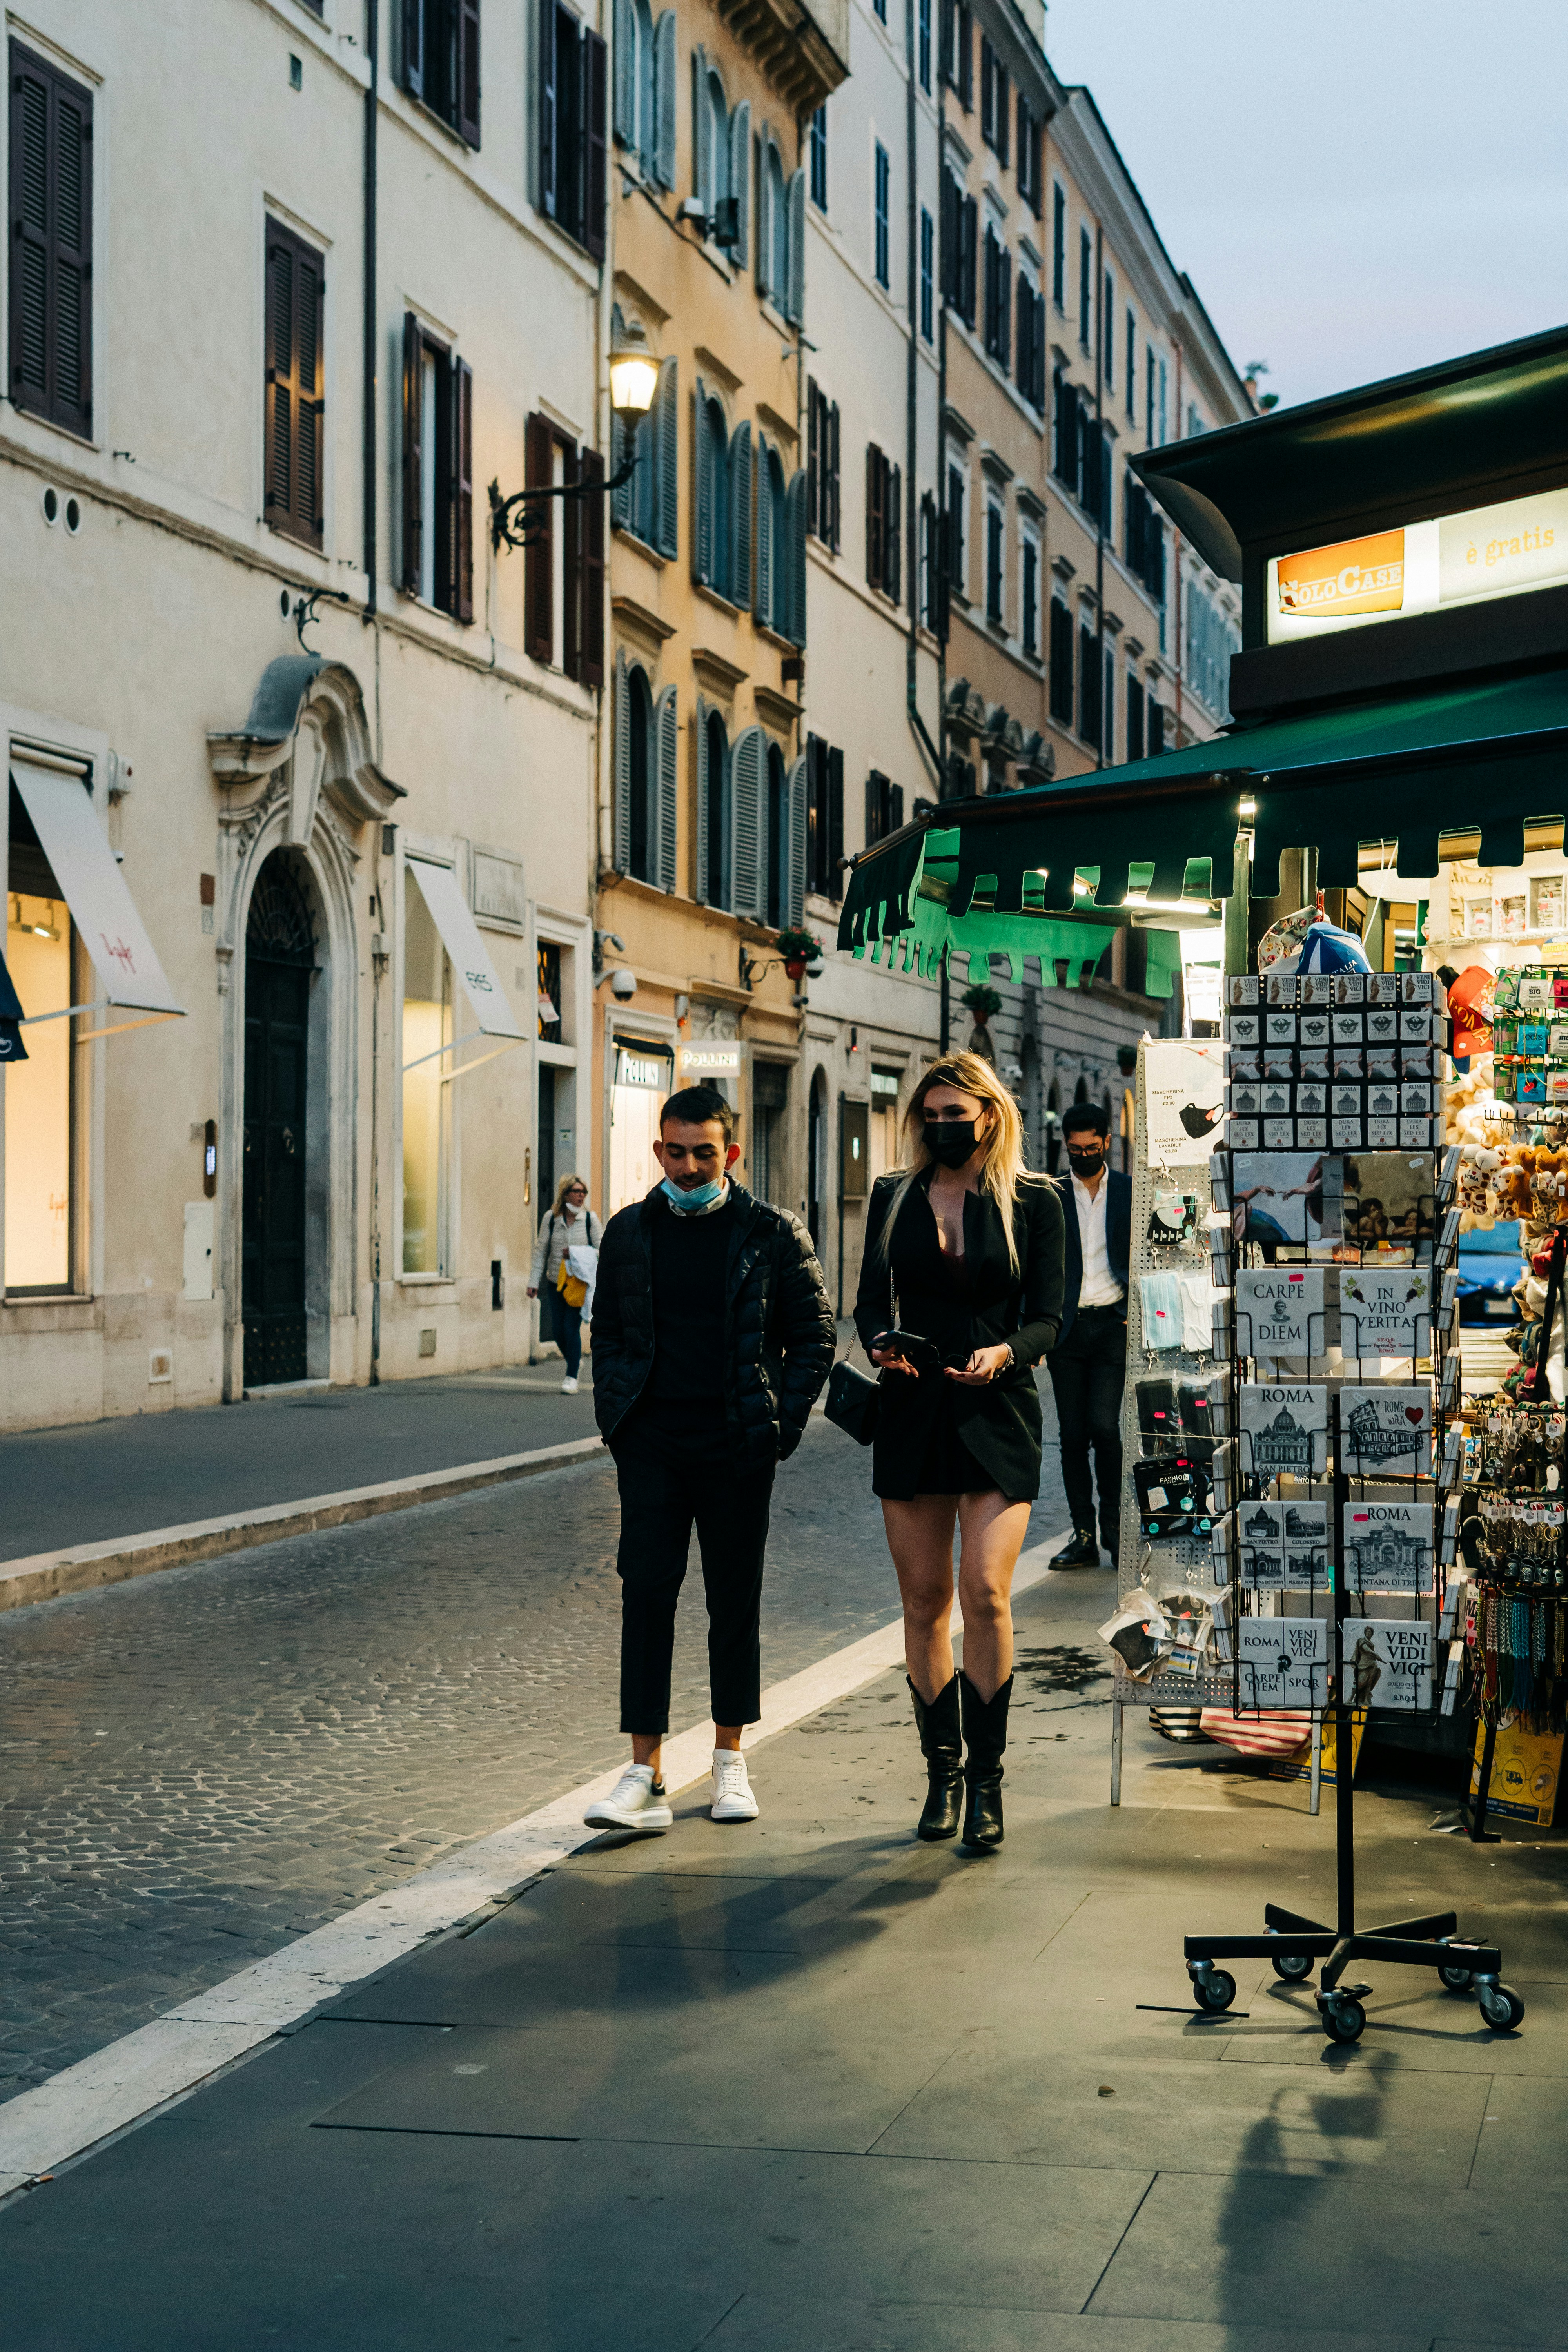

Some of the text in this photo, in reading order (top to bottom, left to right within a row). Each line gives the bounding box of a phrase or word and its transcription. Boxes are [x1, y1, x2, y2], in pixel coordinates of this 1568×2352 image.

[1466, 526, 1554, 566] è gratis
[1449, 996, 1492, 1047] ROMA
[683, 1051, 737, 1066] POLLINI
[1254, 1284, 1304, 1298] CARPE
[1377, 1287, 1393, 1299] IN
[1368, 1302, 1405, 1314] VINO
[1357, 1316, 1418, 1328] VERITAS
[1259, 1325, 1301, 1339] DIEM
[1261, 1389, 1314, 1403] ROMA
[1384, 1401, 1405, 1412] ROME
[1160, 1474, 1189, 1483] FASHION
[1367, 1508, 1411, 1521] ROMA
[1289, 1629, 1318, 1639] VENI
[1385, 1631, 1428, 1646] VENI
[1244, 1637, 1281, 1647] ROMA
[1290, 1639, 1316, 1648] VIDI
[1291, 1647, 1316, 1657] VICI
[1387, 1646, 1426, 1660] VIDI
[1389, 1661, 1425, 1675] VICI
[1244, 1673, 1280, 1683] CARPE
[1289, 1678, 1320, 1690] SPQR
[1248, 1682, 1279, 1691] DIEM
